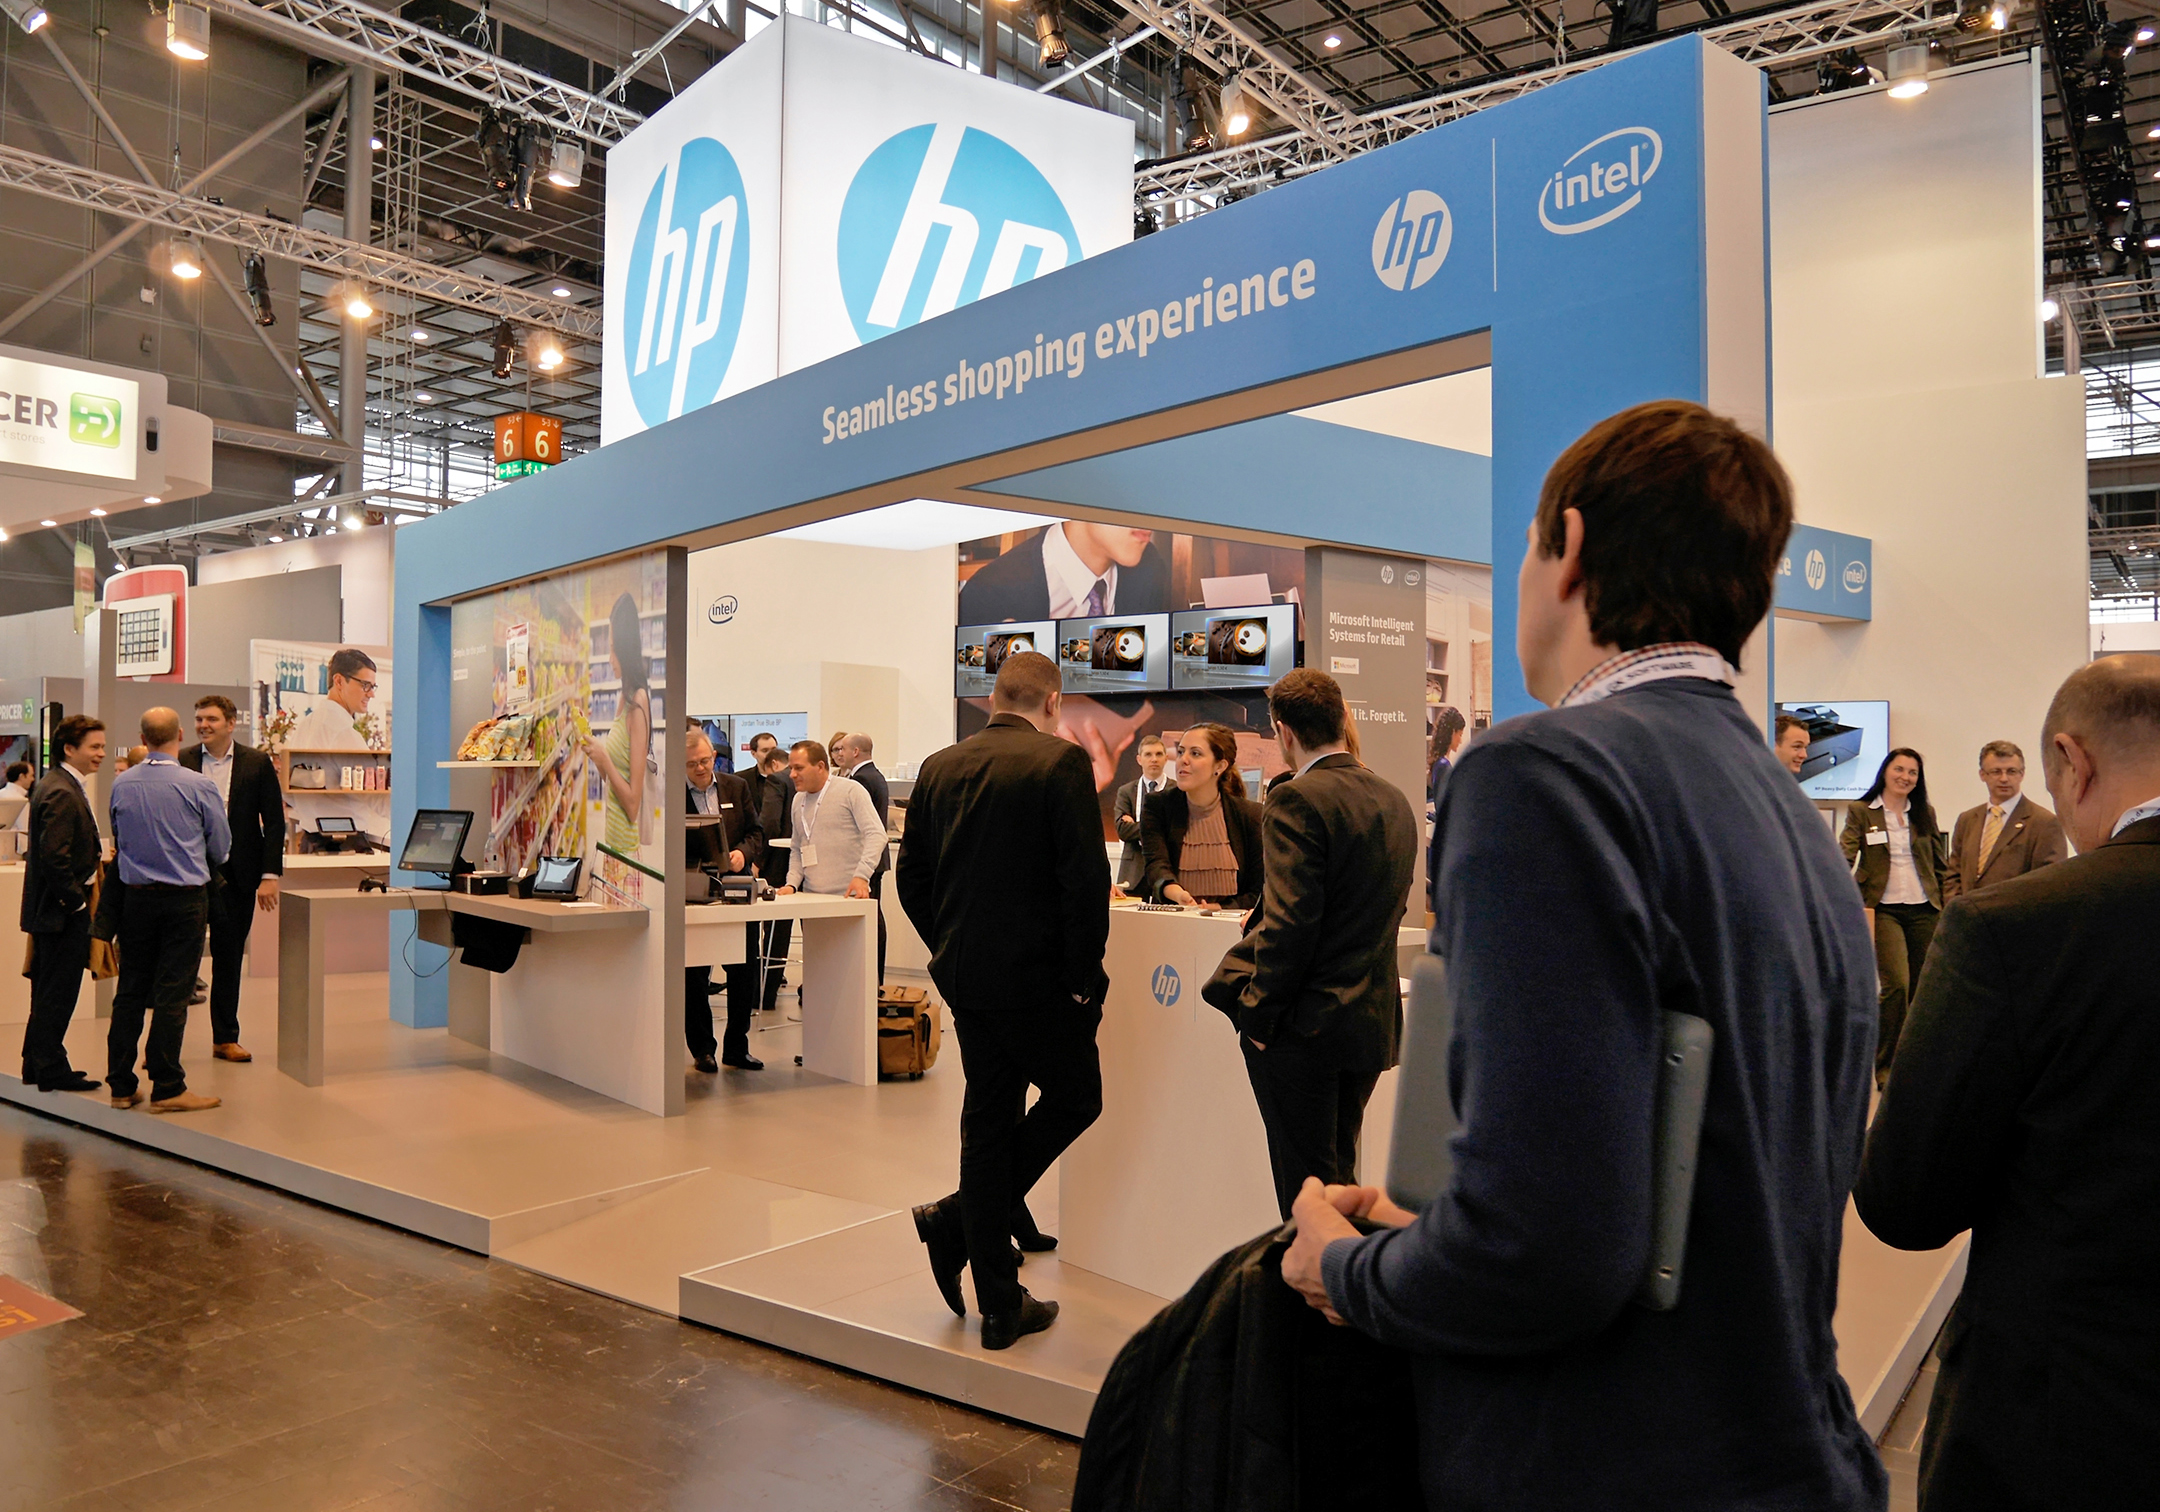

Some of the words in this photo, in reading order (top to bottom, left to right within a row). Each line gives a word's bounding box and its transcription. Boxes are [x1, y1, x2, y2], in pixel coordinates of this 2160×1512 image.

[1555, 145, 1640, 210] intel
[1380, 191, 1446, 291] hp
[634, 145, 739, 421] hp
[822, 379, 938, 445] Seamless
[943, 331, 1087, 407] shopping
[1094, 257, 1317, 359] experience
[10, 430, 46, 445] stores
[503, 428, 514, 458] 6
[535, 430, 550, 459] 6
[1382, 564, 1394, 585] hp
[1806, 549, 1825, 590] hp
[712, 601, 734, 616] intel
[1329, 611, 1371, 628] Microsoft
[1371, 615, 1415, 633] Intelligent
[1329, 628, 1366, 643] Systems
[1366, 631, 1380, 644] for
[1380, 632, 1406, 647] Retail
[1358, 708, 1369, 721] it.
[1369, 709, 1397, 724] Forget
[1397, 710, 1408, 723] it.
[1154, 964, 1180, 1007] hp
